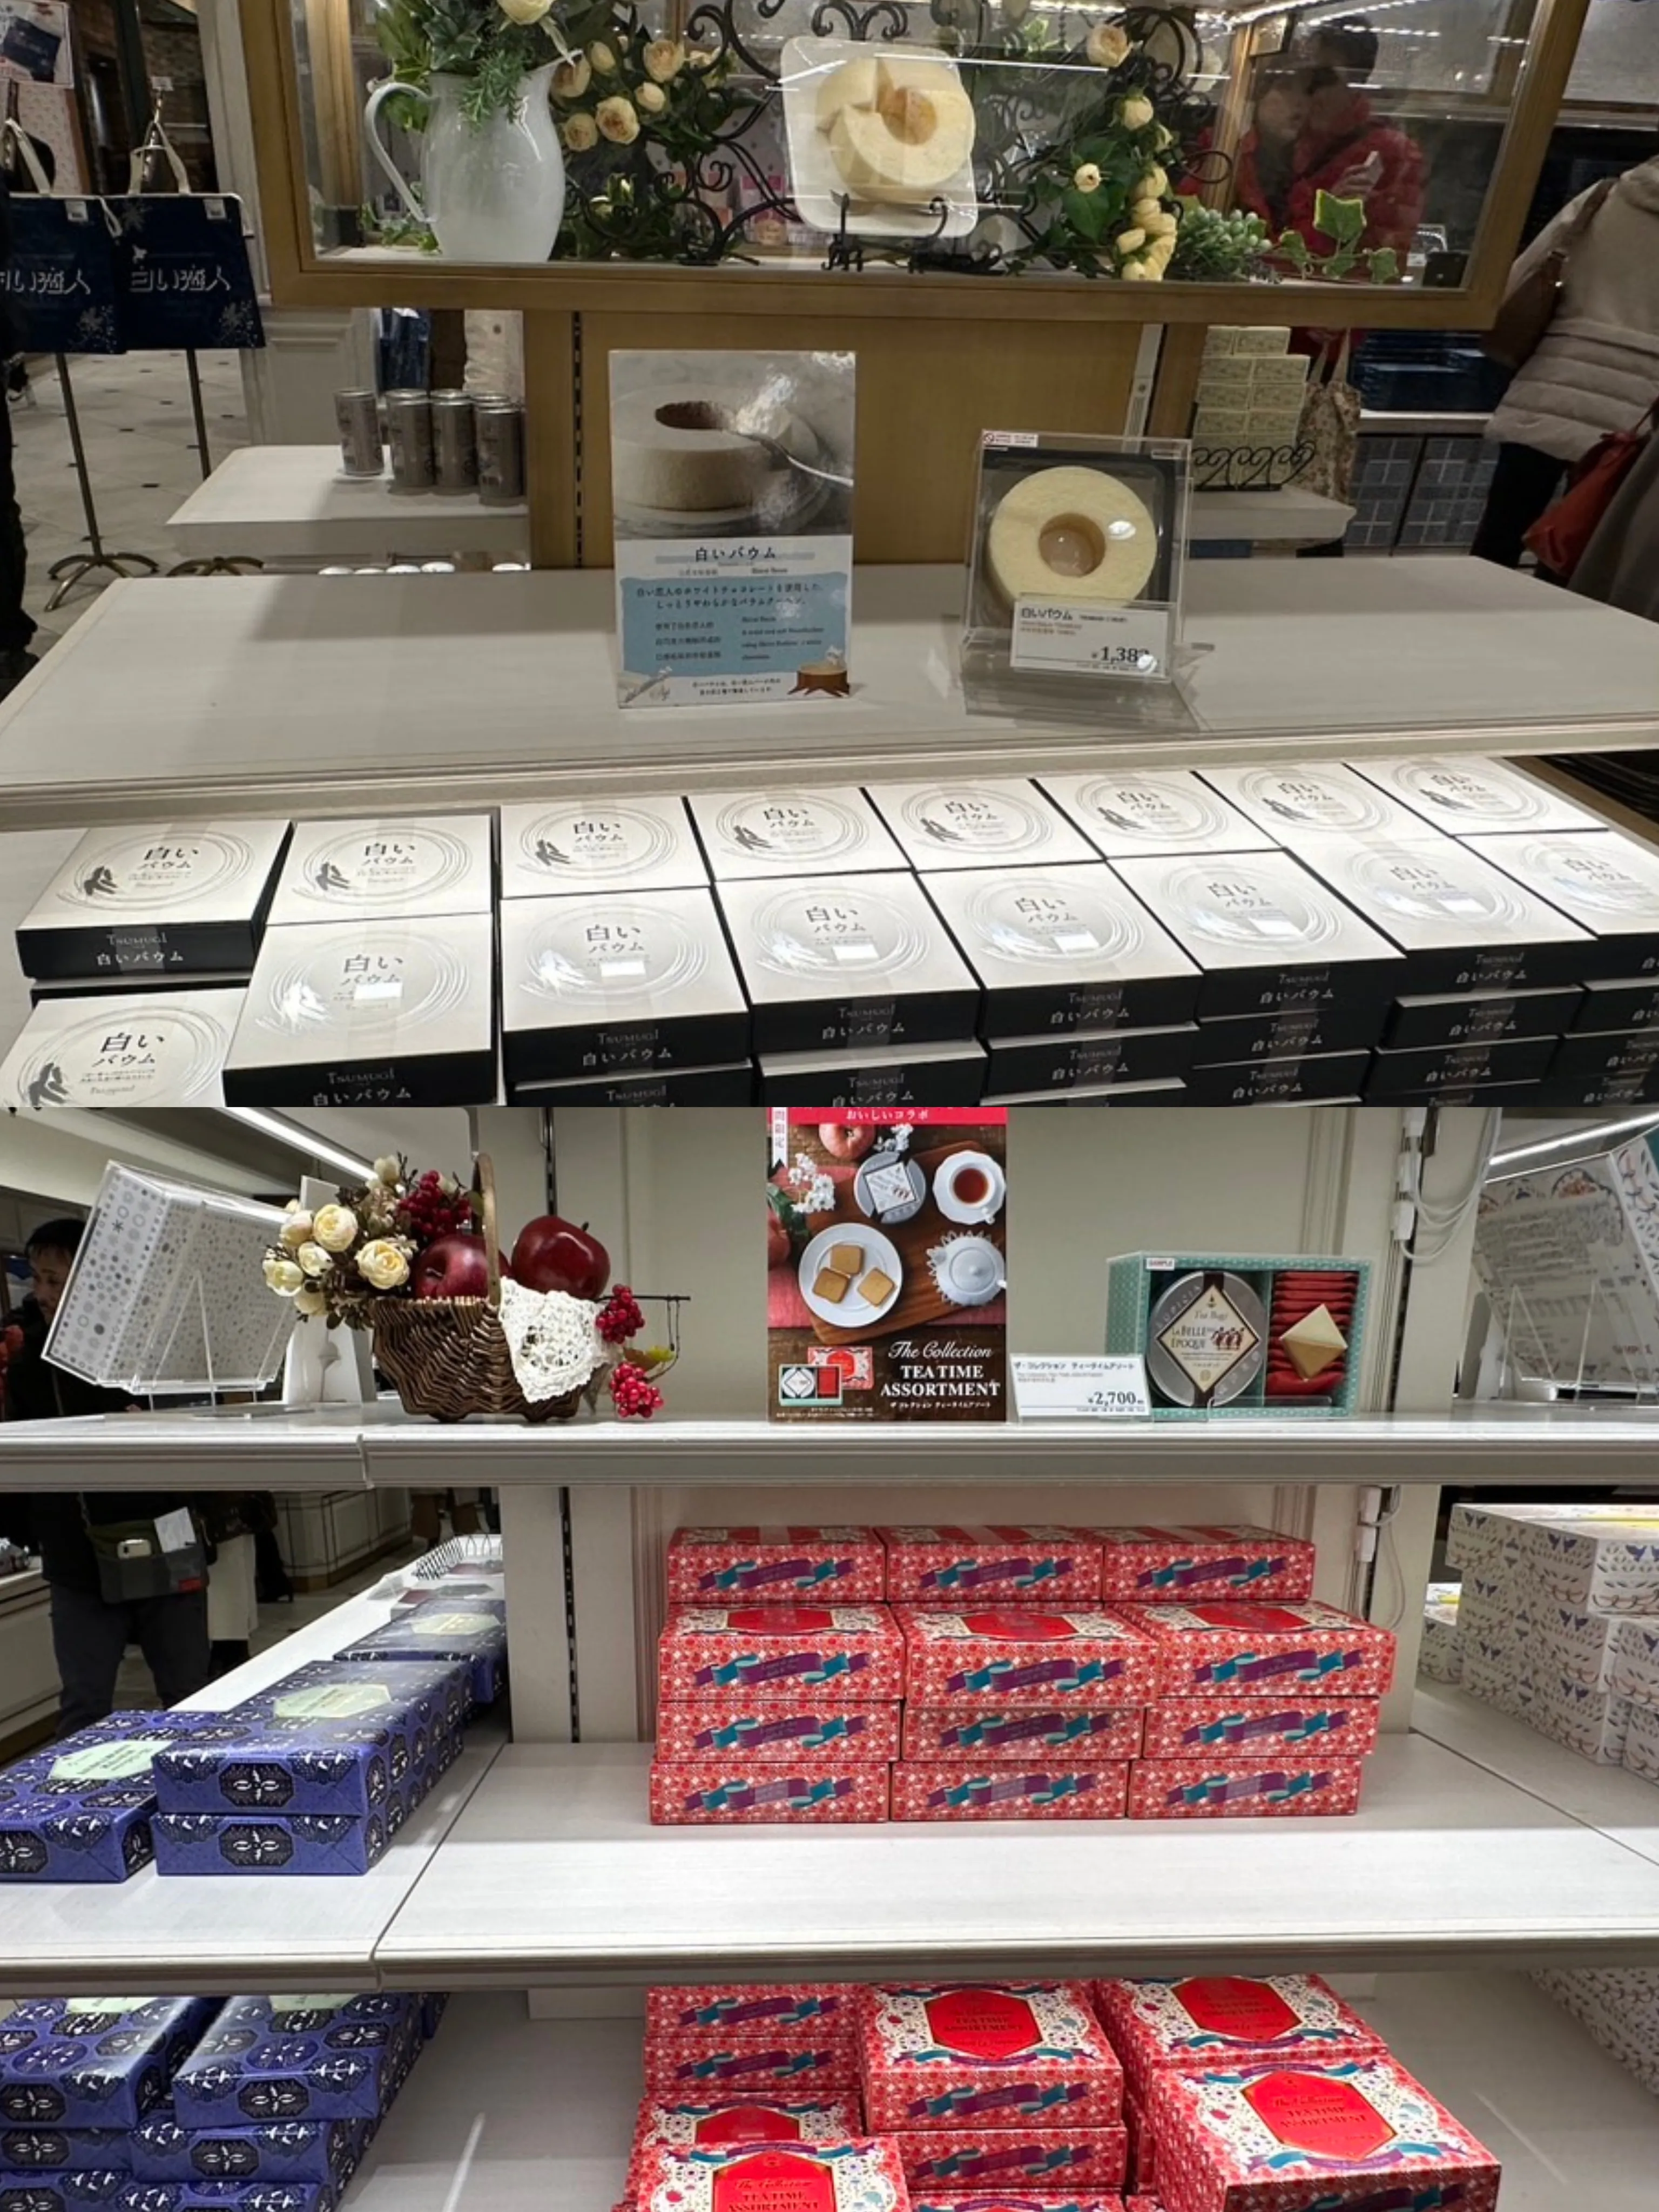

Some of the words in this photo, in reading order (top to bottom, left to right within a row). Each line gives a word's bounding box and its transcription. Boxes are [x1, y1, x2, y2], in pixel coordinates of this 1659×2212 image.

[696, 546, 776, 563] 白いバウム
[1022, 608, 1073, 621] 白いバウム
[1015, 897, 1067, 913] 白い
[805, 906, 859, 922] 白い
[586, 924, 642, 941] 白い
[814, 922, 866, 933] バウム
[589, 941, 644, 954] バウム
[97, 951, 184, 966] 白いバウム
[343, 954, 404, 974] 白い
[341, 974, 401, 986] バウム
[1050, 1008, 1129, 1024] 白いバウム
[822, 1023, 905, 1040] 白いバウム
[100, 1032, 165, 1053] 白い
[92, 1053, 156, 1068] バウム
[583, 1048, 672, 1067] 白いバウム
[312, 1087, 412, 1107] 白いバウム
[846, 1109, 929, 1121] おいしいコラボ
[888, 1341, 919, 1358] The
[922, 1340, 993, 1359] Collection
[881, 1381, 1001, 1397] ASSORTMENT
